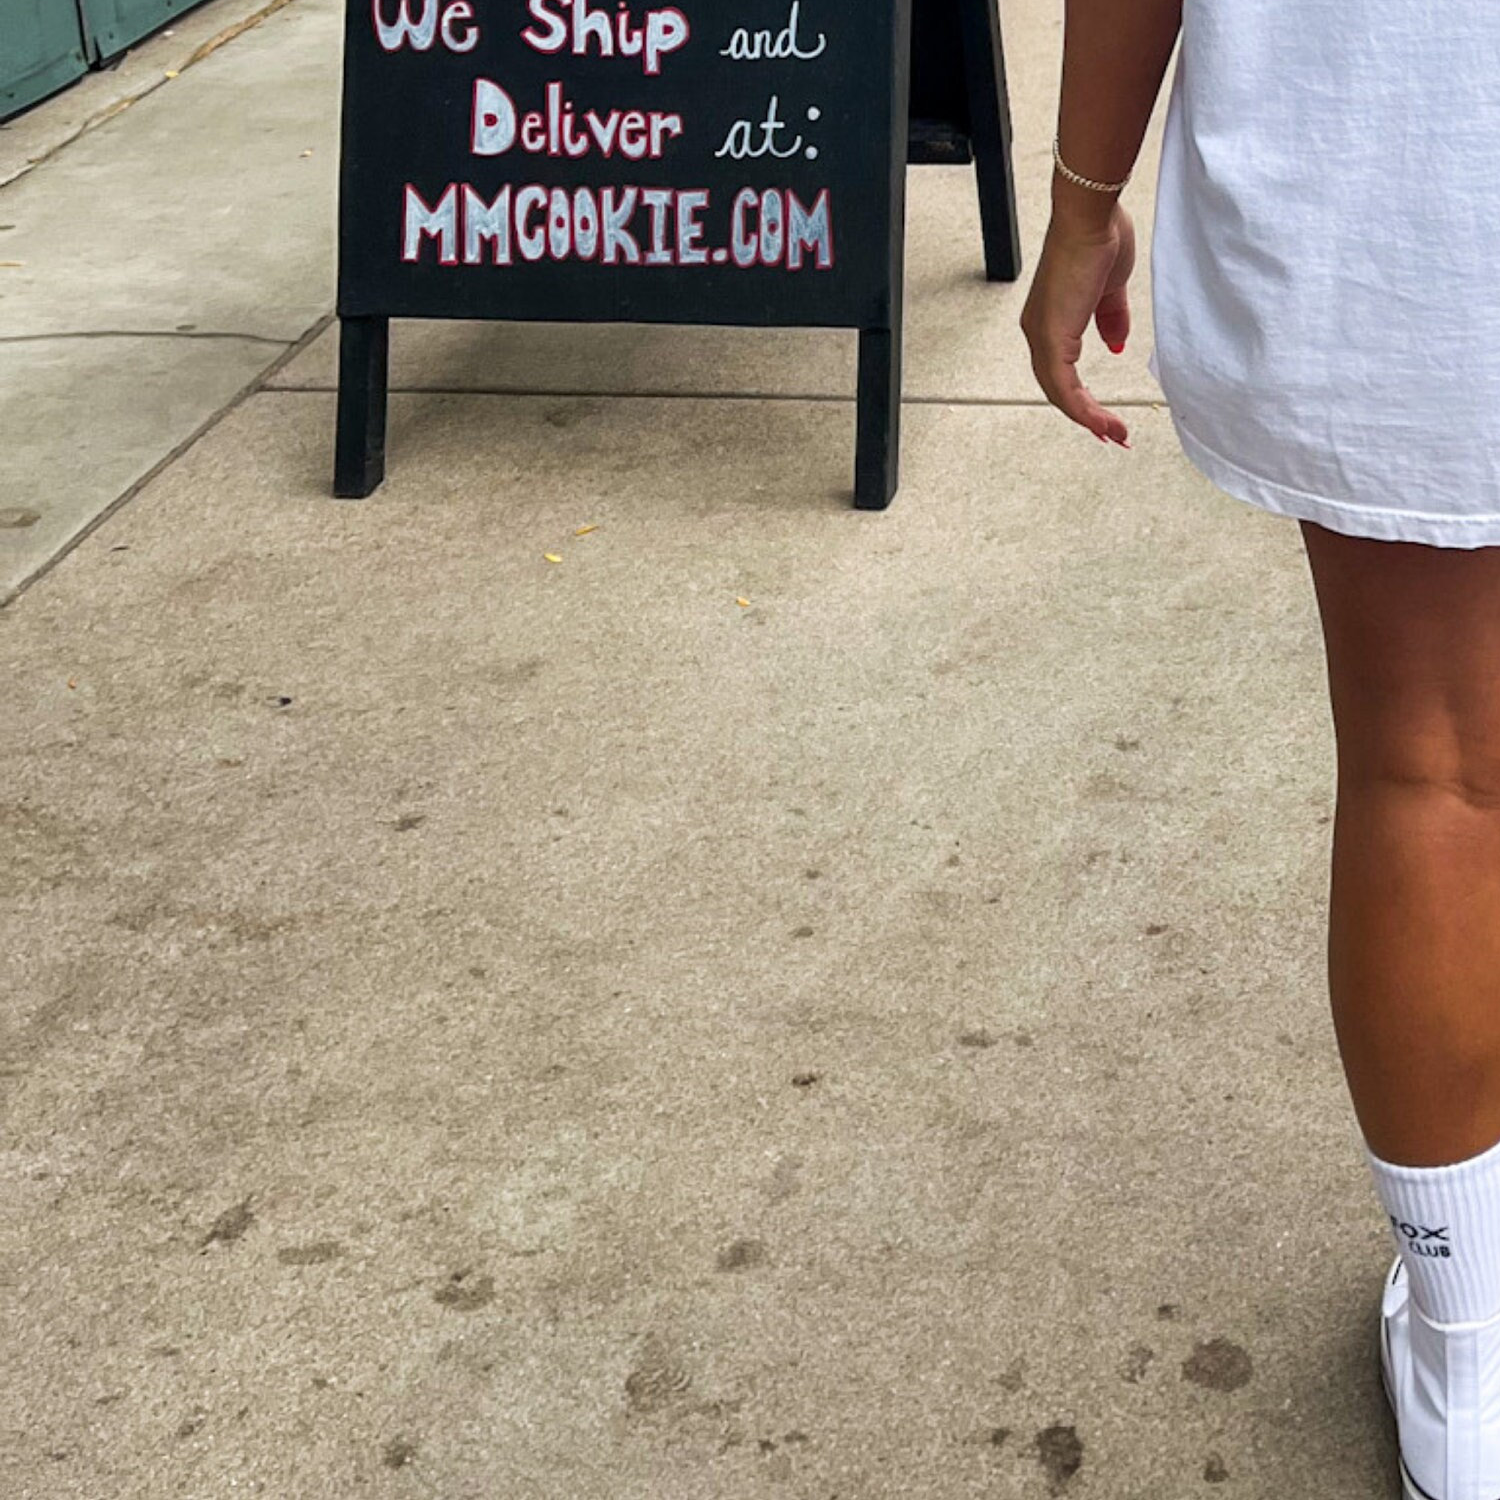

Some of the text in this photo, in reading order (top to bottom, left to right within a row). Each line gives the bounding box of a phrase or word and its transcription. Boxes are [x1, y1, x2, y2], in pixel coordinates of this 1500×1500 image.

[719, 0, 827, 60] and
[470, 77, 822, 160] Deliver at:
[402, 182, 834, 270] MMCOOKIE.COM
[1408, 1240, 1451, 1258] CLUB
